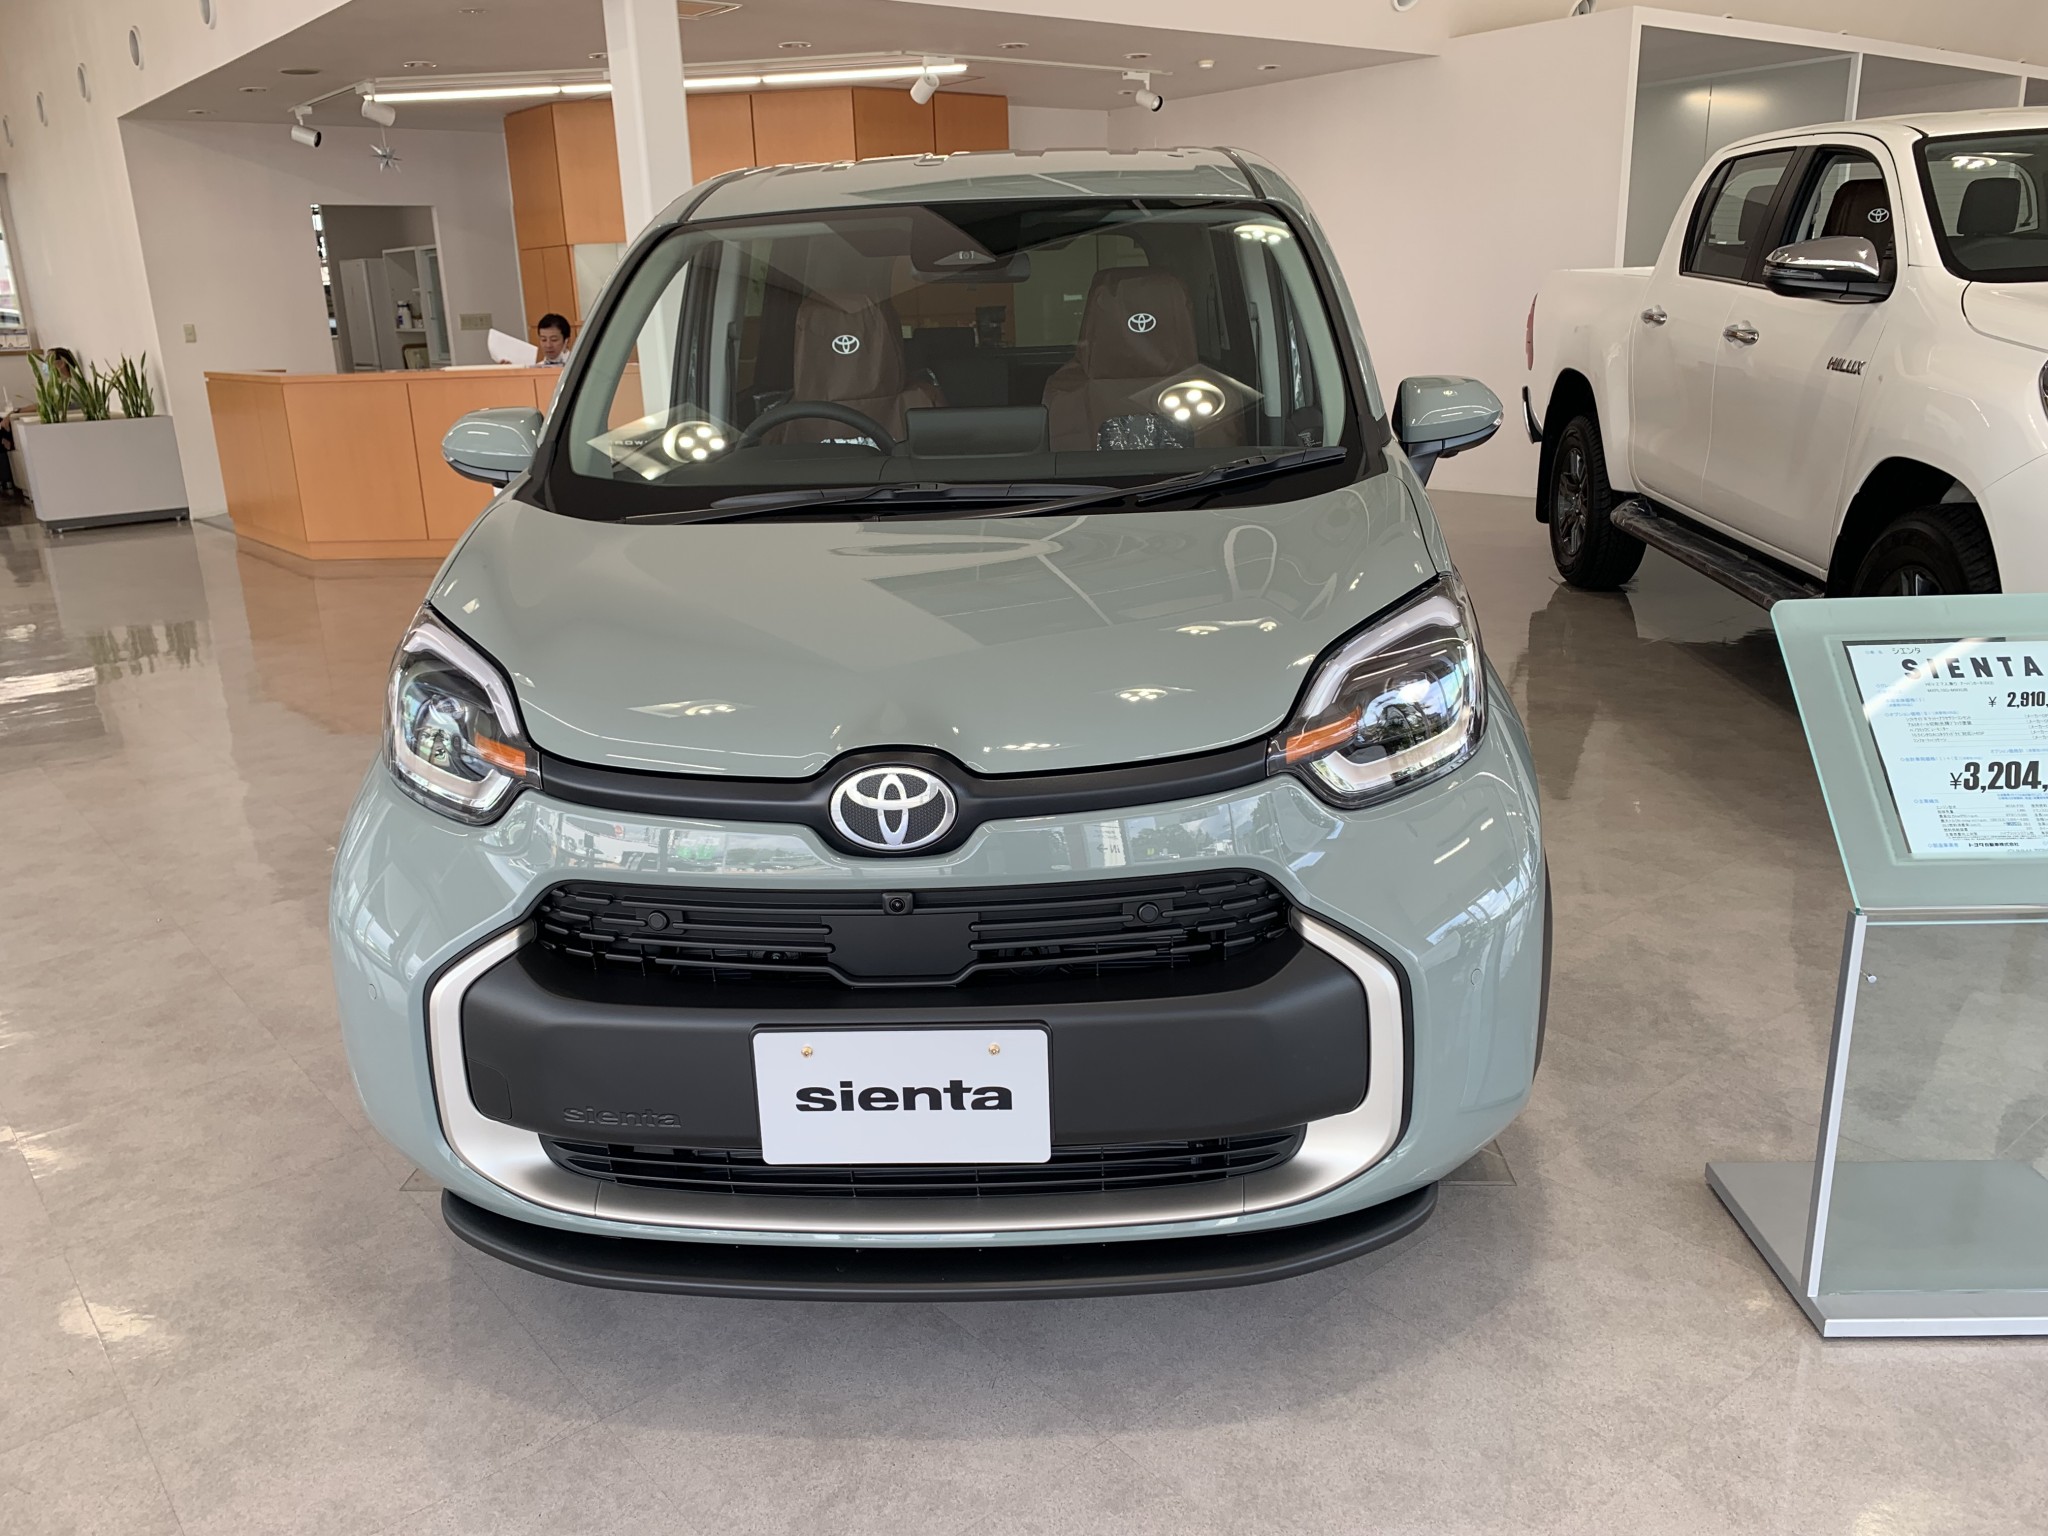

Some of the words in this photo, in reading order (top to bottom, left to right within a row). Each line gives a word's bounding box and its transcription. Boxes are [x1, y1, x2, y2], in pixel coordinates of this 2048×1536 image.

[1827, 356, 1866, 375] HILUX
[1892, 646, 1922, 655] シエンタ
[1901, 656, 2044, 680] SIENTA
[796, 1080, 1012, 1112] sienta
[563, 1106, 681, 1128] sienta
